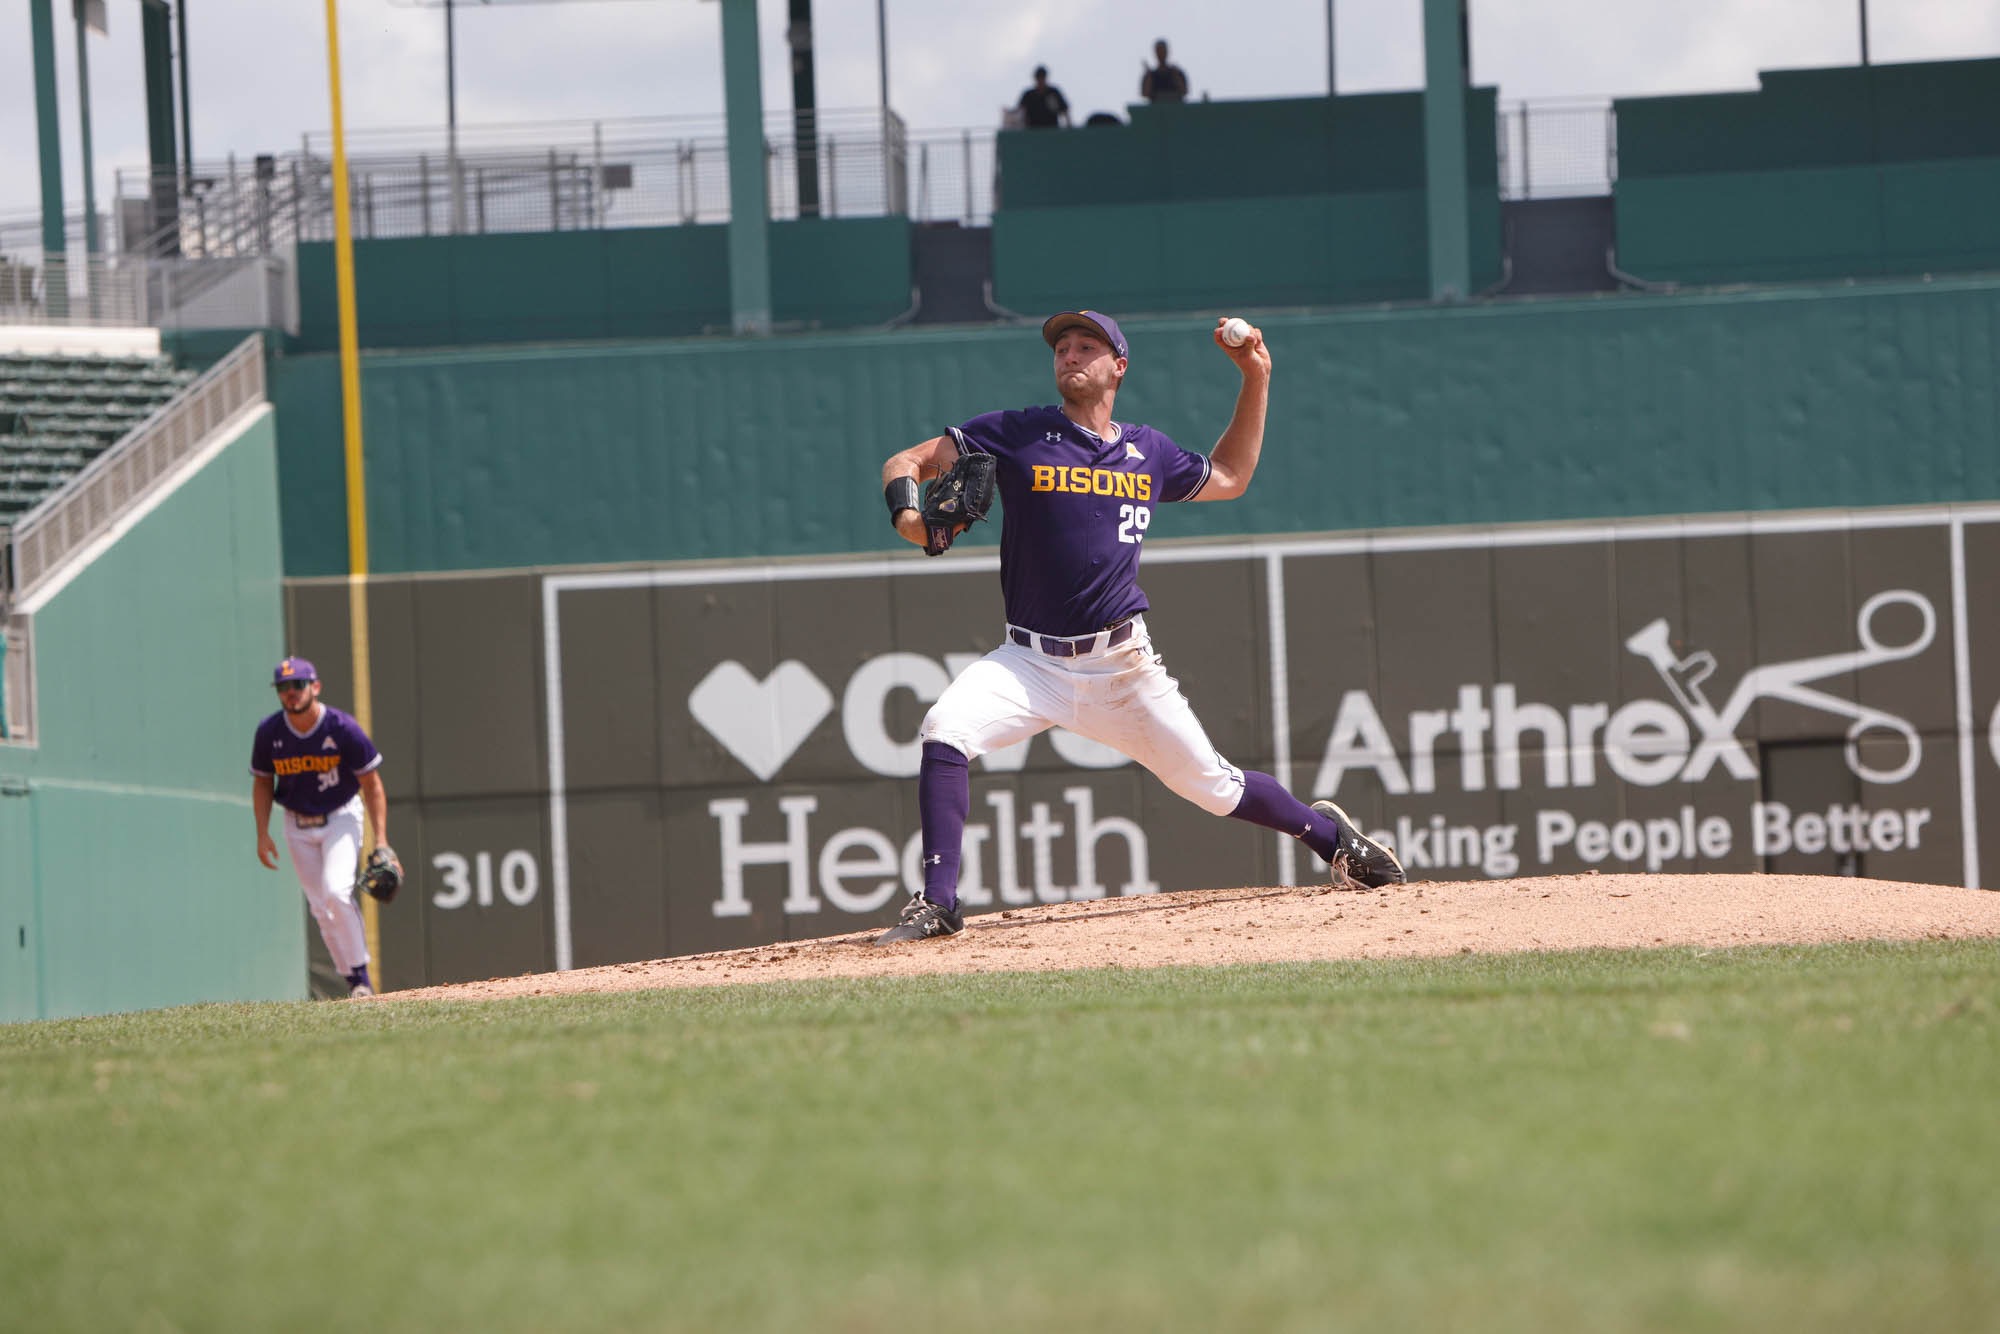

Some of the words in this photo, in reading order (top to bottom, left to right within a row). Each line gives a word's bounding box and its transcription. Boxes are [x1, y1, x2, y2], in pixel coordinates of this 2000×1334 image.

[1031, 464, 1151, 501] BISONS
[1118, 503, 1151, 544] 29
[281, 660, 295, 676] L
[1312, 681, 1758, 800] Arthrex
[708, 786, 1160, 917] Health
[1536, 805, 1732, 872] People
[1751, 801, 1932, 856] Better
[432, 850, 540, 908] 310
